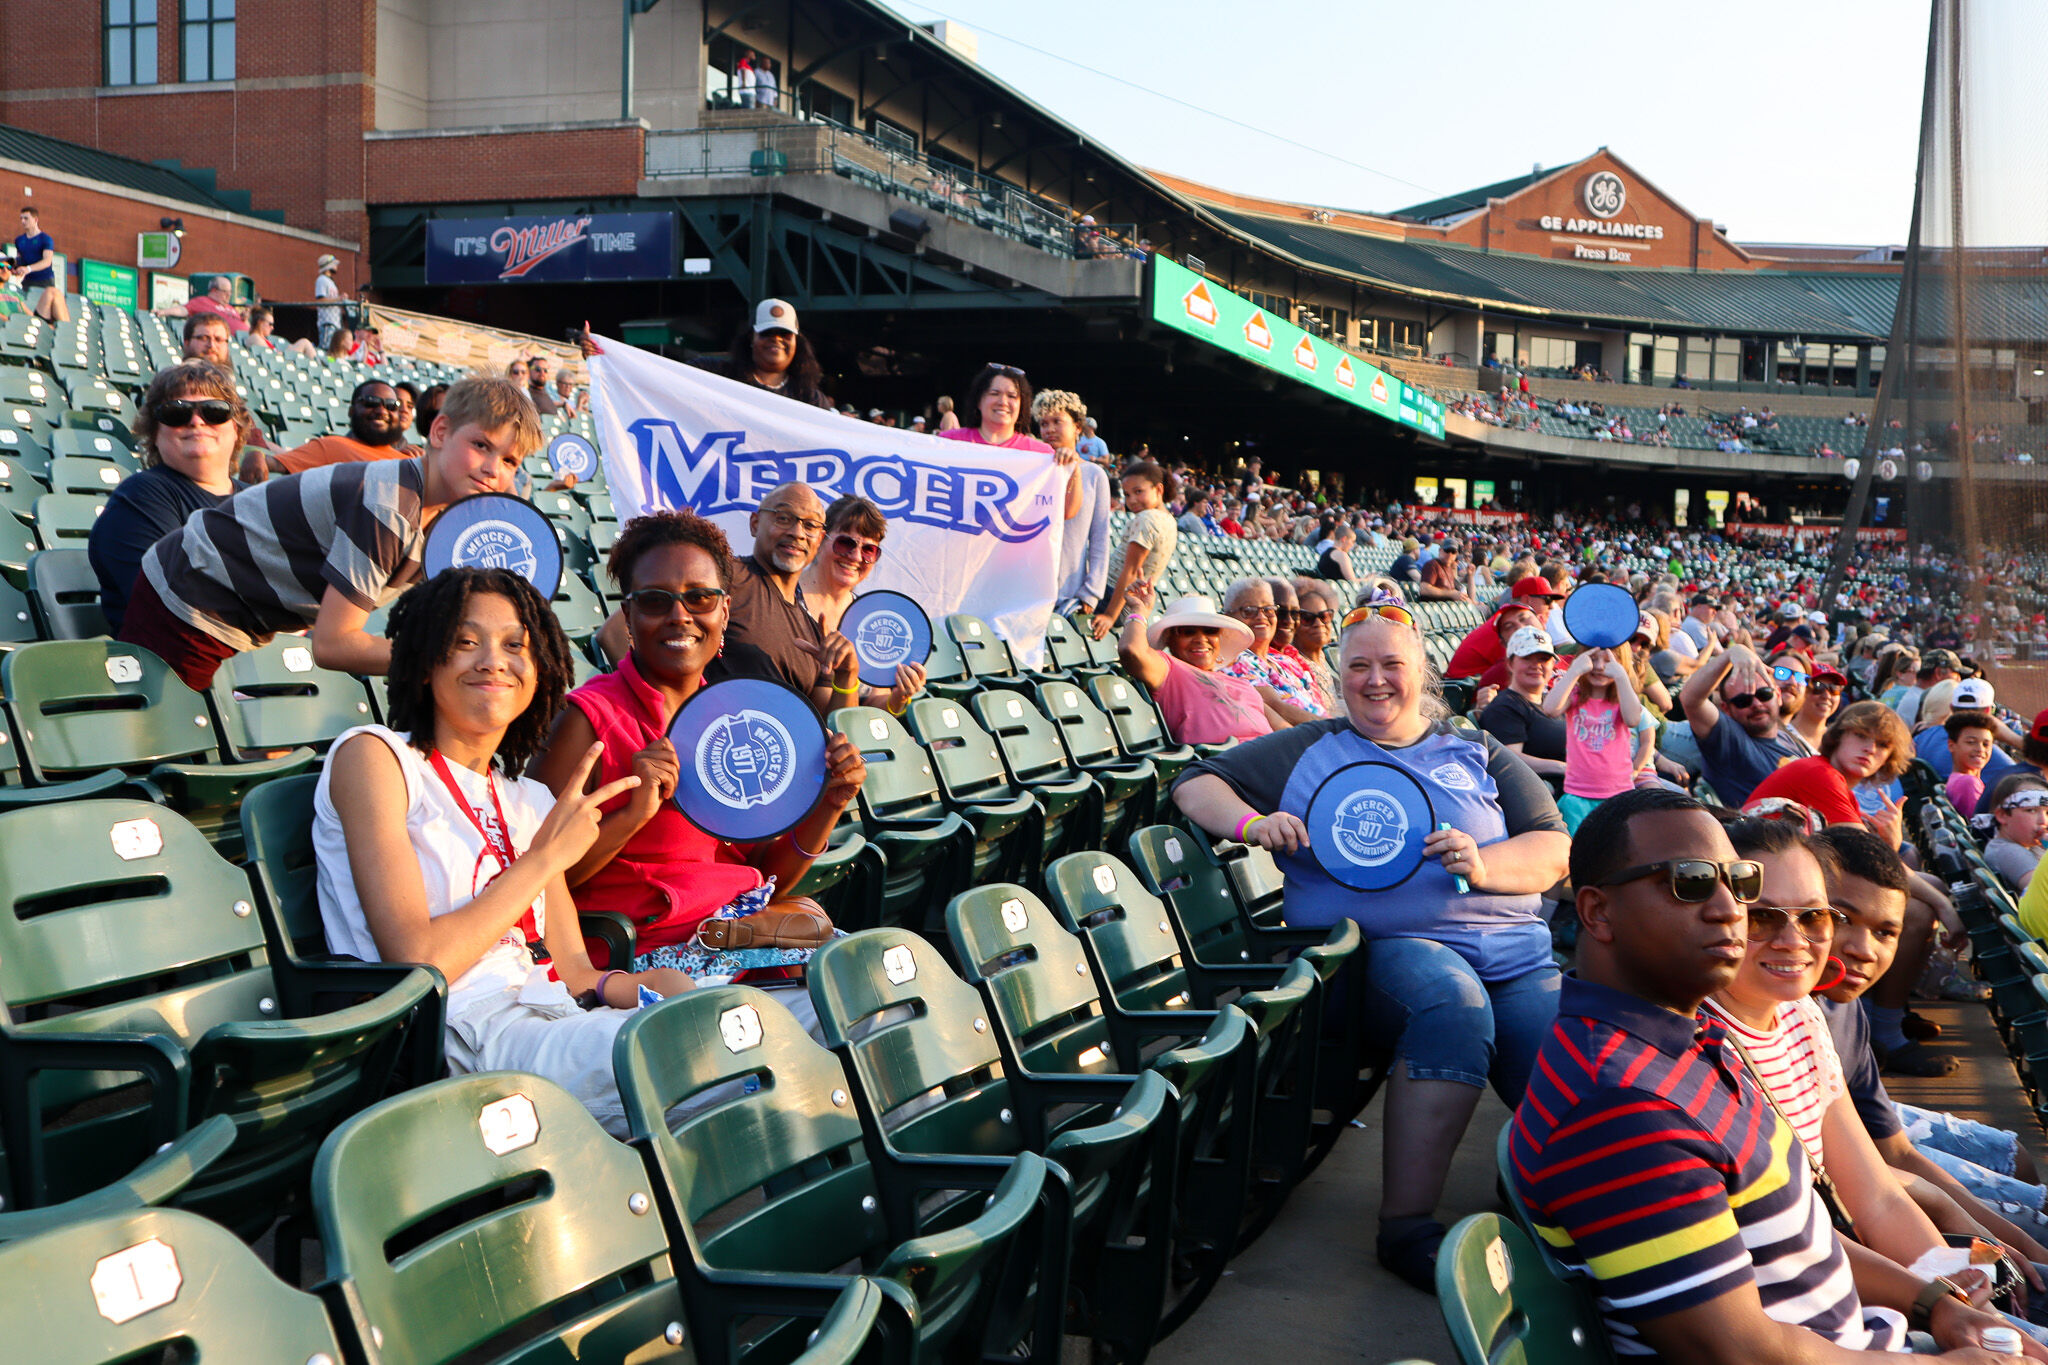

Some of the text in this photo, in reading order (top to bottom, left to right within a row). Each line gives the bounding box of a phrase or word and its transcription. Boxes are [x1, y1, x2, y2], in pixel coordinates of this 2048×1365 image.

[1540, 216, 1664, 240] GE APPLIANCES
[454, 217, 637, 269] IT'S Miller TIME
[1575, 244, 1632, 262] Press Box
[628, 418, 1053, 543] MERCER TM
[466, 531, 513, 555] MERCER
[870, 617, 903, 634] MERCER
[875, 634, 894, 648] 1977
[731, 743, 757, 774] 1977
[754, 726, 783, 782] MERCER
[1352, 800, 1395, 821] MERCER
[1358, 820, 1382, 840] 1977
[895, 952, 904, 974] 4
[734, 1014, 746, 1041] 3
[500, 1107, 518, 1140] 2
